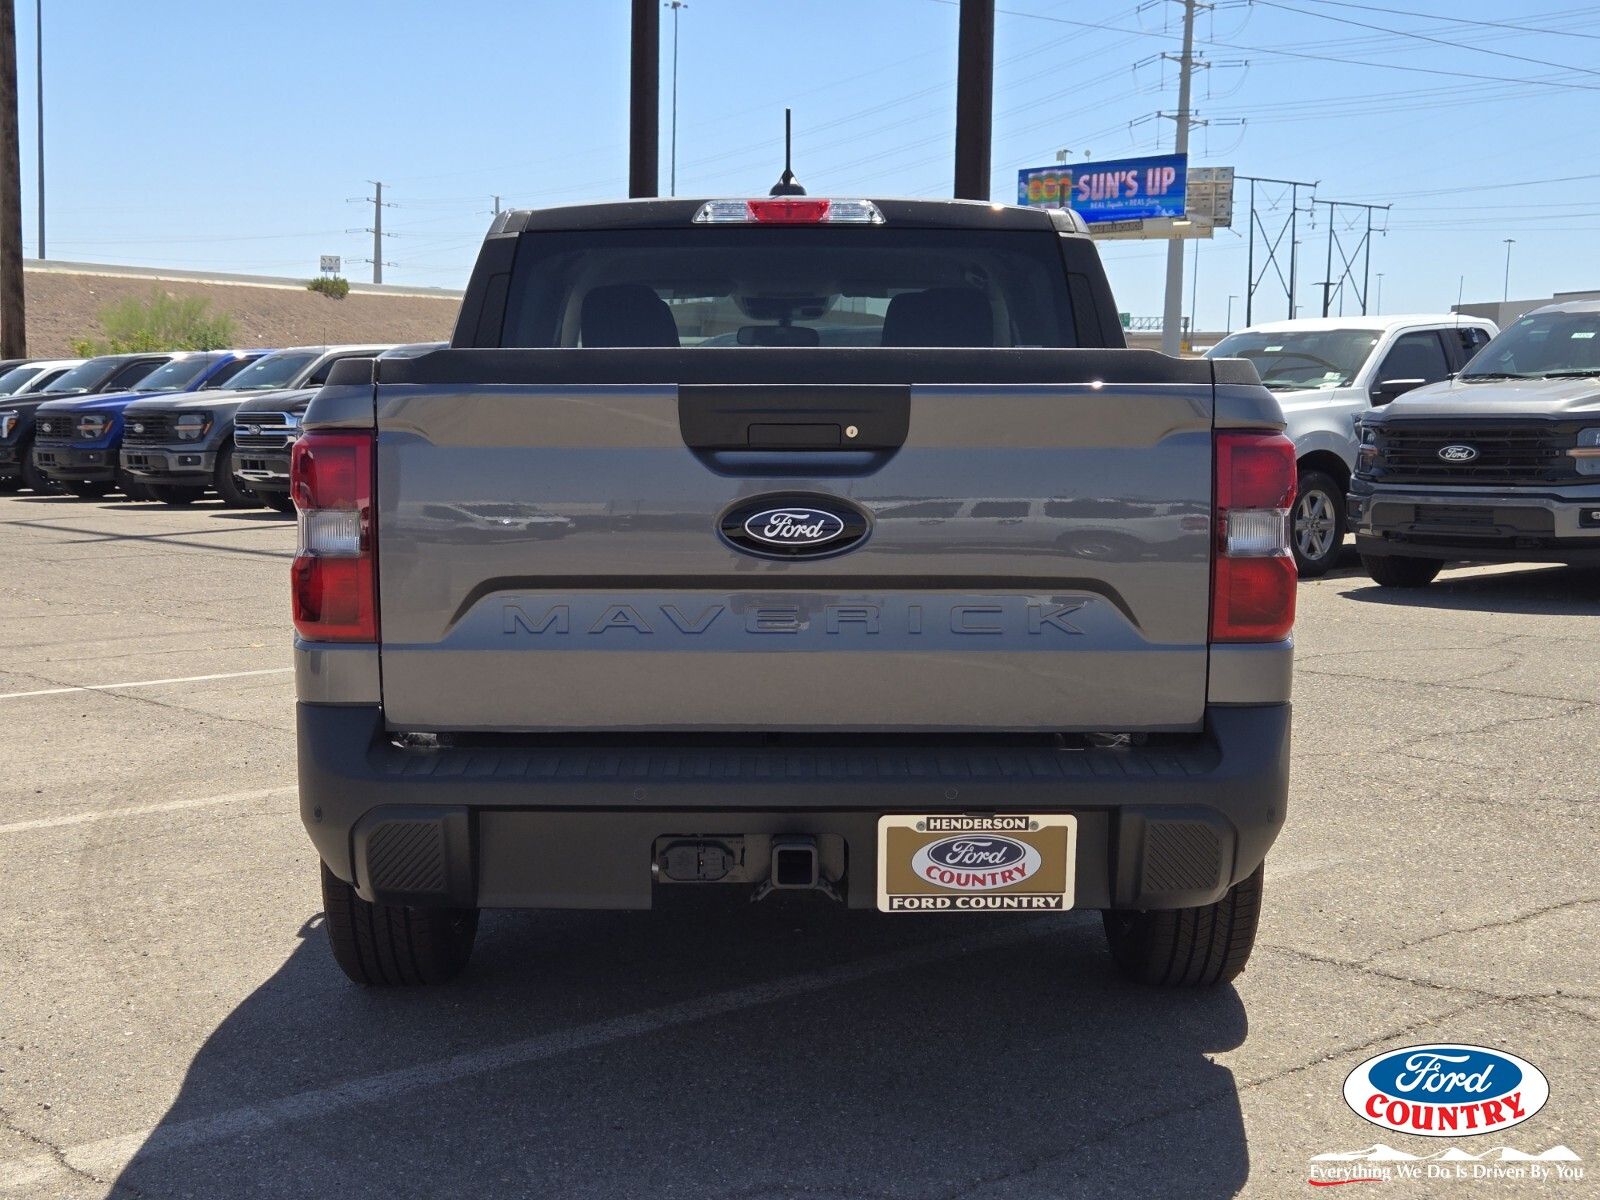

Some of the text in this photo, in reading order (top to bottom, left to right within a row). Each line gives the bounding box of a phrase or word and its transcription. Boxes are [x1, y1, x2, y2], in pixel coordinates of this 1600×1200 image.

[1077, 167, 1175, 202] SUN'S UP
[1445, 447, 1469, 458] Ford
[764, 512, 825, 538] Ford
[502, 604, 1087, 636] MAVERICK
[929, 818, 1026, 830] HENDERSON
[945, 840, 1008, 865] Ford
[925, 863, 1027, 887] COUNTRY
[892, 897, 1060, 909] FORD COUNTRY
